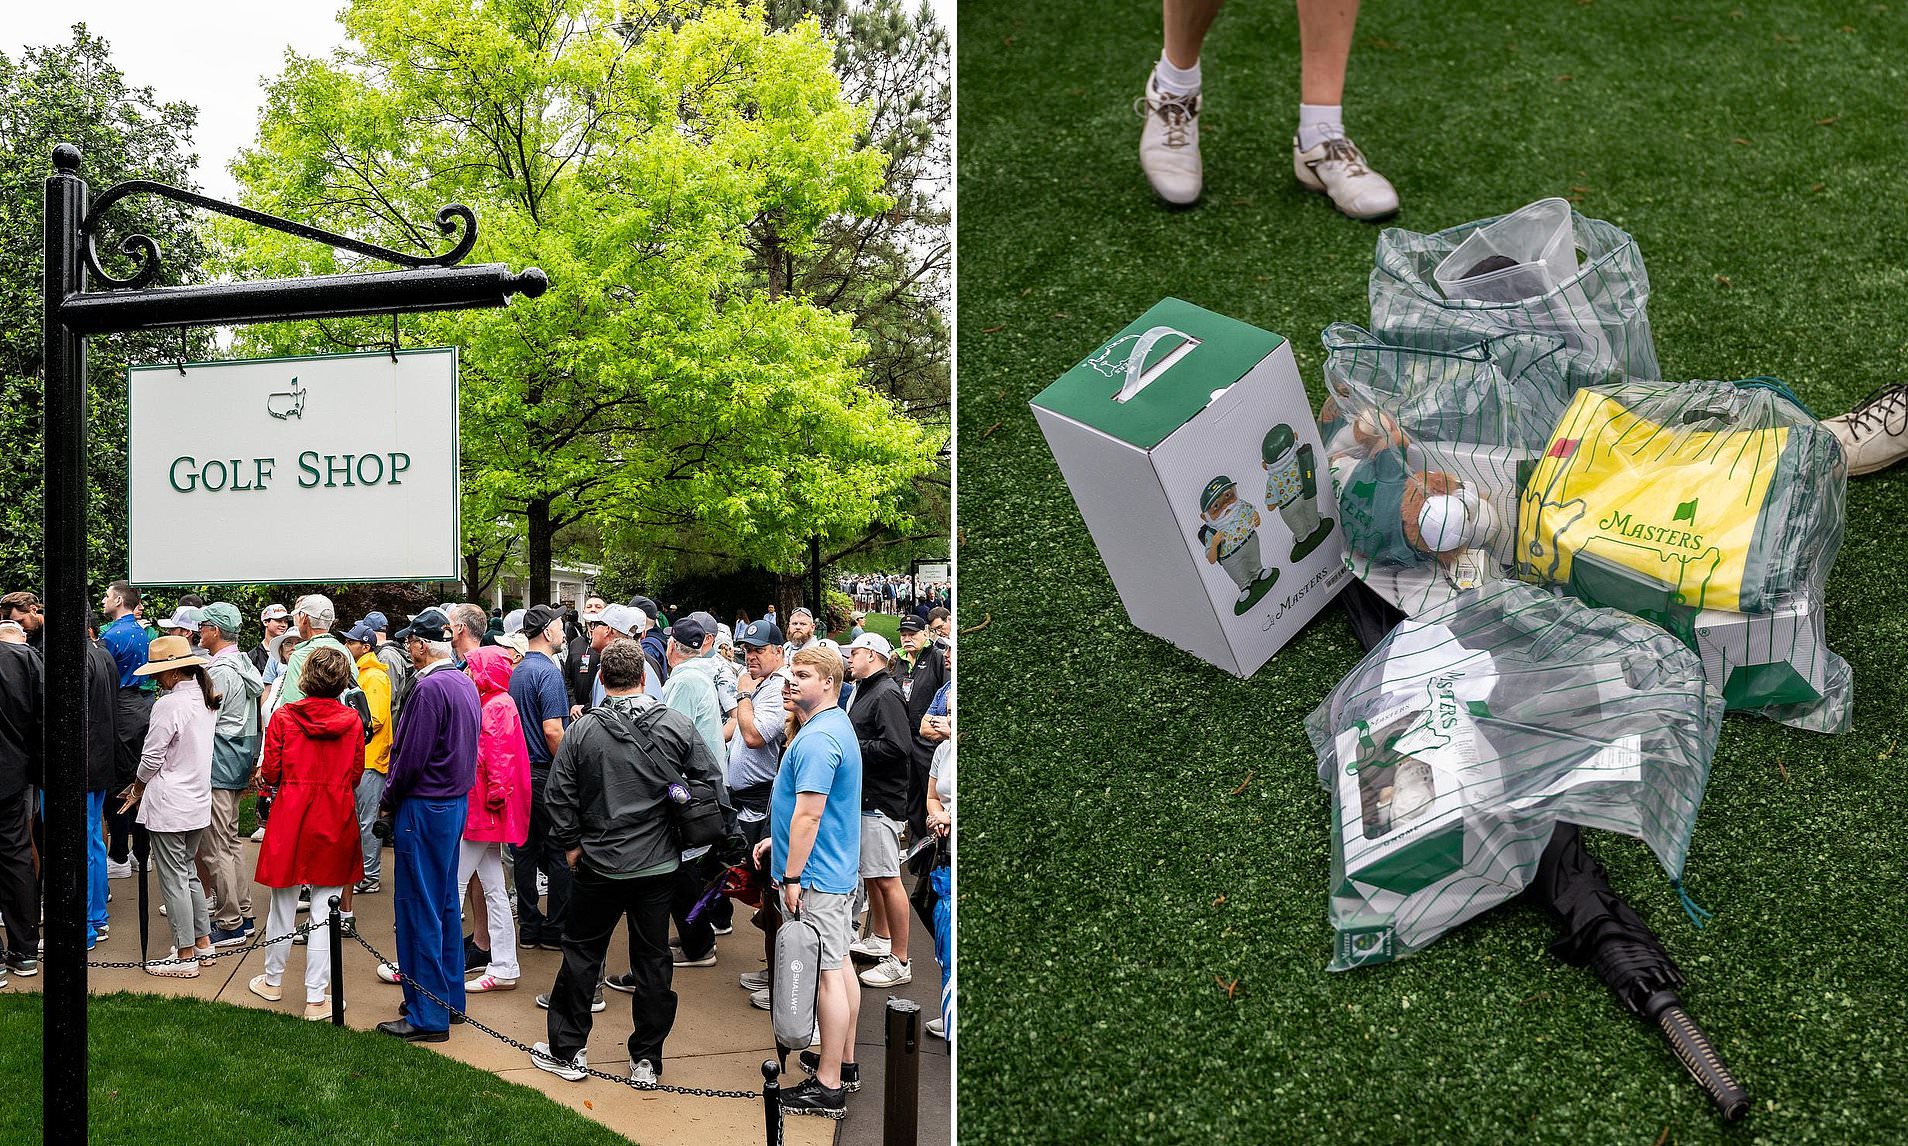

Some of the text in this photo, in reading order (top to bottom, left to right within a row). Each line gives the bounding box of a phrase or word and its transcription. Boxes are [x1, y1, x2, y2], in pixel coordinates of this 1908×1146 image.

[169, 450, 411, 493] GOLF SHOP
[1599, 510, 1704, 550] MASTERS
[1276, 567, 1328, 620] MASTERS
[1436, 671, 1466, 729] MSTERS
